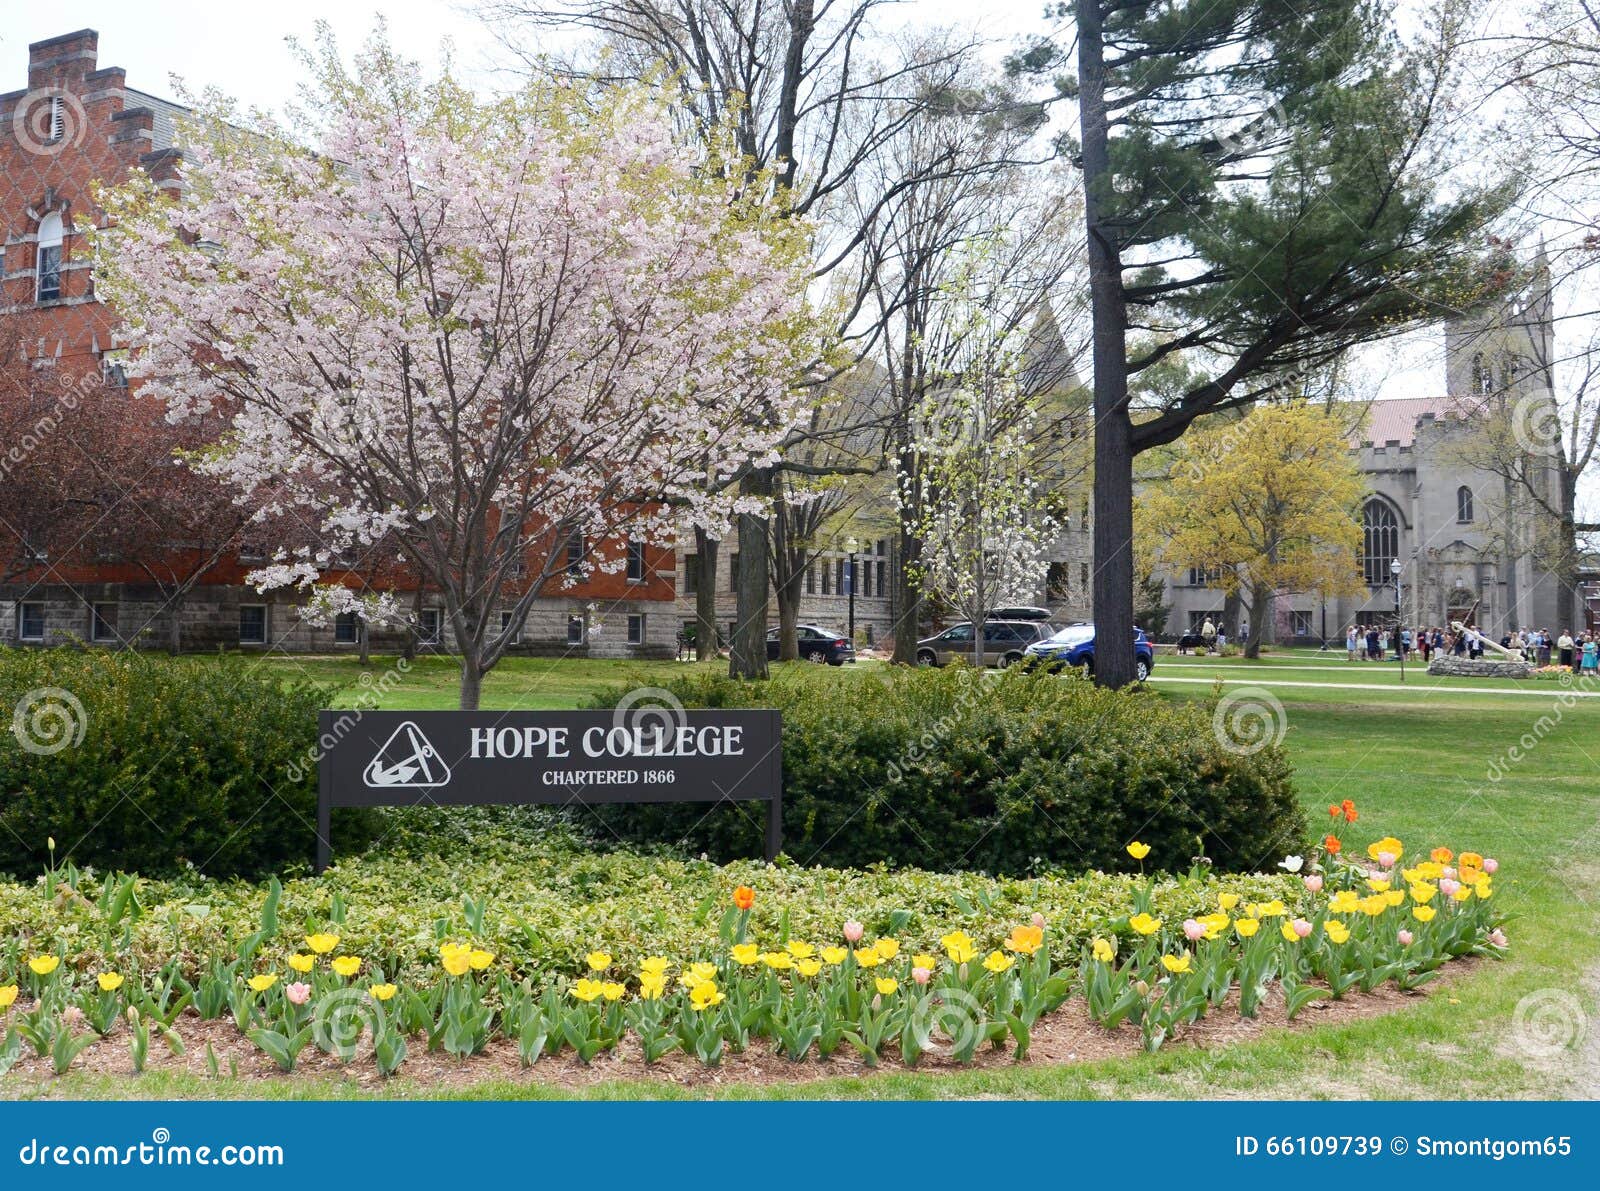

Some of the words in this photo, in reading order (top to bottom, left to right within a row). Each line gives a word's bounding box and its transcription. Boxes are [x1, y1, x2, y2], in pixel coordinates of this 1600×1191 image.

[470, 727, 570, 759] HOPE
[582, 725, 744, 758] COLLEGE
[542, 769, 638, 786] CHARTERED
[643, 769, 676, 784] 1866
